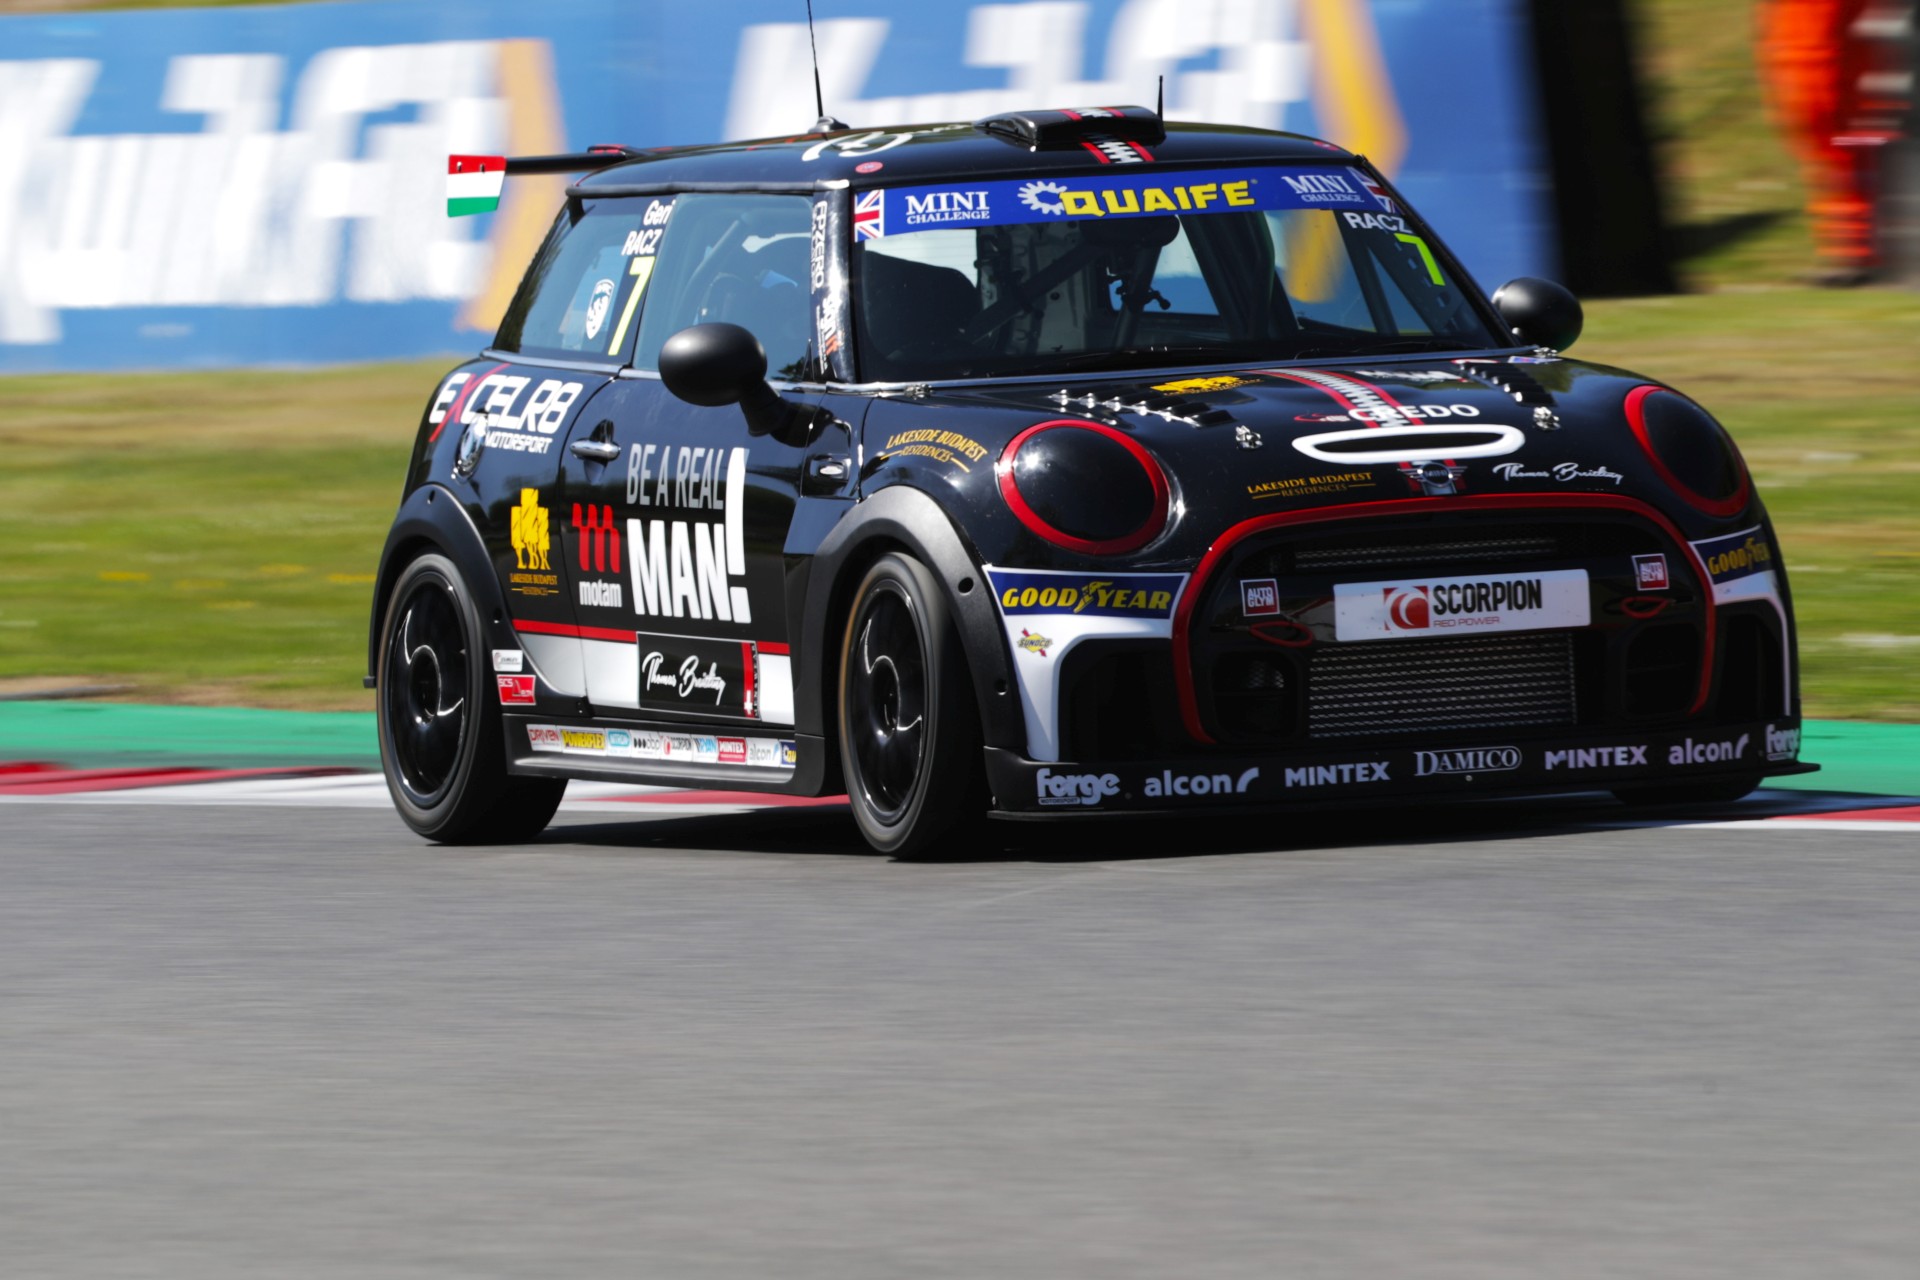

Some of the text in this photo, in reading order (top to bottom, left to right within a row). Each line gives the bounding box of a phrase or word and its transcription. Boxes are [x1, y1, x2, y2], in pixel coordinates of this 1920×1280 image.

[1281, 174, 1357, 195] MINI
[905, 191, 990, 215] MINI
[1058, 180, 1256, 217] QUAIFE
[1301, 192, 1365, 203] CHALLENGE
[643, 199, 676, 226] Geri
[906, 210, 990, 225] CHALLENGE
[1343, 212, 1413, 233] RACZ
[621, 228, 662, 256] RACZ
[1393, 232, 1446, 286] 7
[608, 256, 656, 356] 7
[428, 363, 584, 443] EXCELR8
[1348, 403, 1480, 422] CREDO
[484, 430, 553, 454] MOTORSPORT
[885, 428, 988, 462] LAKESIDE BUDAPEST
[901, 444, 953, 463] RESIDENCES
[626, 443, 725, 510] BE A REAL
[1247, 471, 1373, 494] LAKESIDE BUDAPEST
[1281, 483, 1348, 498] RESIDENCES
[626, 447, 752, 624] MAN!
[579, 579, 622, 607] motam
[1247, 587, 1273, 598] AUTO
[1248, 597, 1275, 607] GLYM
[1432, 579, 1543, 616] SCORPION
[1433, 615, 1501, 628] RED POWER
[1018, 638, 1052, 649] SUNOCO
[718, 739, 745, 754] MINTEX
[749, 743, 771, 761] alcon
[1544, 745, 1648, 770] MINTEX
[1669, 738, 1734, 765] alcon
[1285, 761, 1391, 788] MINTEX
[1413, 747, 1519, 777] DAMICO
[1036, 767, 1121, 804] forge
[1144, 769, 1232, 797] alcon
